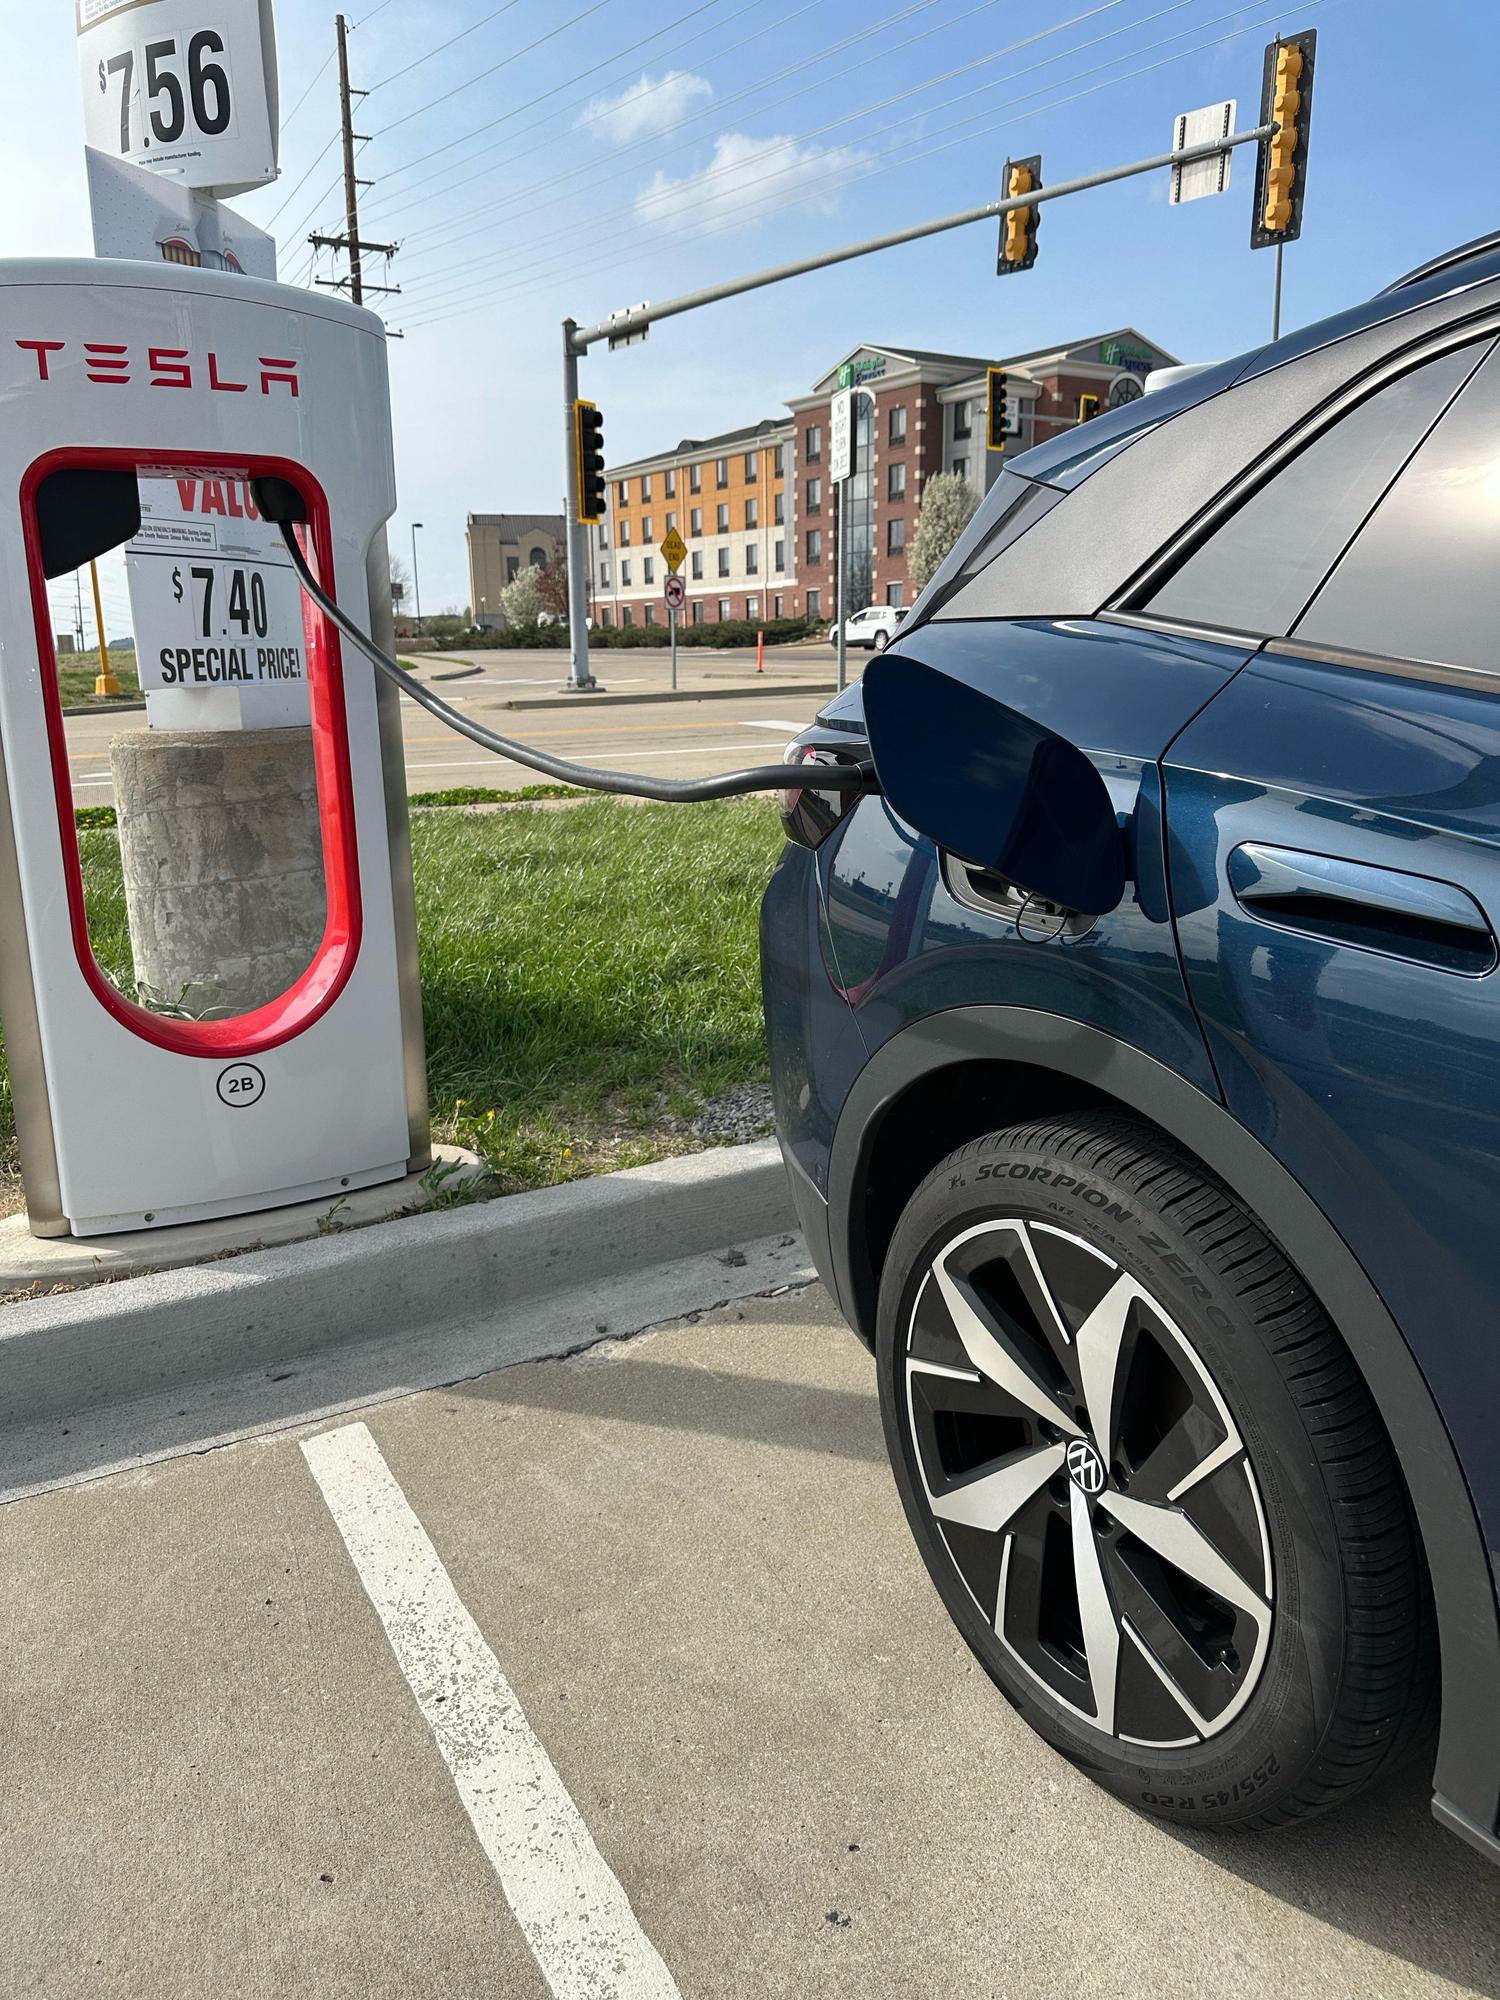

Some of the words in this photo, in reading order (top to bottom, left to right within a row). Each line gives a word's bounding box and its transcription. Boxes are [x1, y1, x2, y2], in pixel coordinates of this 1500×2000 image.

[98, 30, 231, 154] $7.56
[15, 339, 300, 397] TESLA
[176, 479, 260, 521] VALU
[172, 566, 268, 638] $7.40
[160, 647, 254, 683] SPECIAL
[256, 647, 302, 680] PRICE!
[228, 1076, 254, 1094] 2B
[974, 1162, 1135, 1225] SCORPION
[1136, 1230, 1236, 1336] ZERO
[1140, 1791, 1197, 1810] R20
[1200, 1751, 1281, 1810] 255/45
